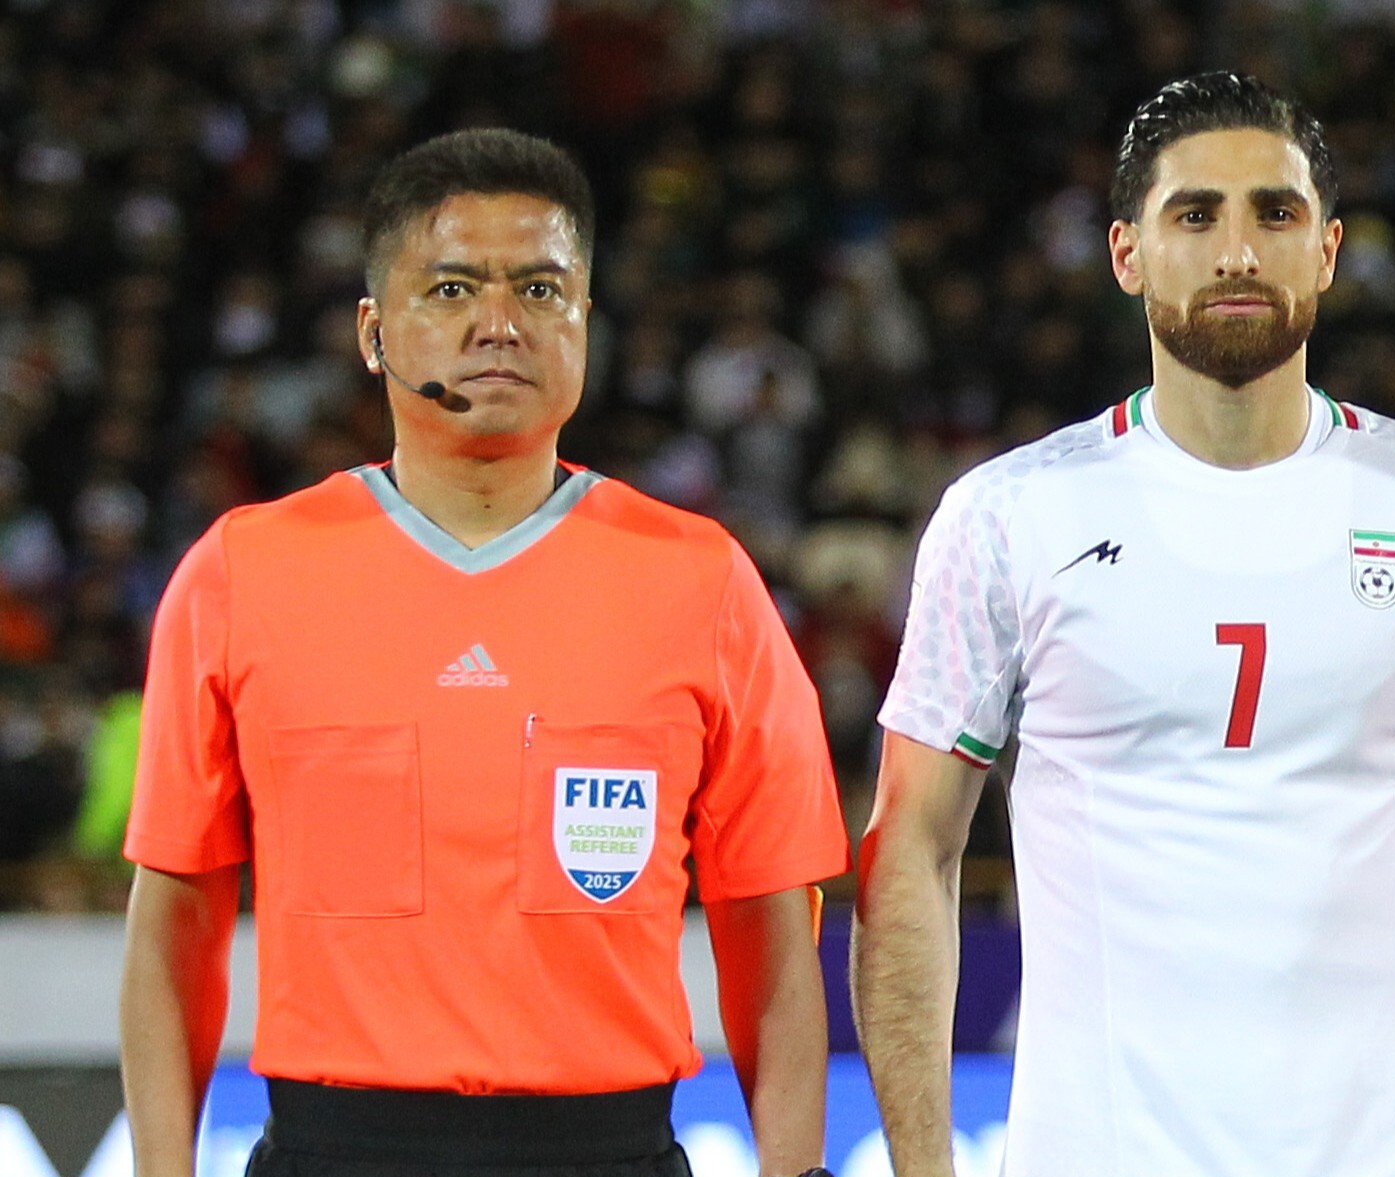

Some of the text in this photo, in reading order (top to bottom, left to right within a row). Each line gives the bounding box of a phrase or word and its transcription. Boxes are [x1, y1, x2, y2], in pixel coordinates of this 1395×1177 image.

[437, 673, 510, 688] adidas
[1215, 622, 1267, 748] 7
[564, 777, 647, 810] FIFA
[564, 823, 645, 839] ASSISTANT
[570, 840, 639, 855] REFEREE
[583, 873, 623, 890] 2025
